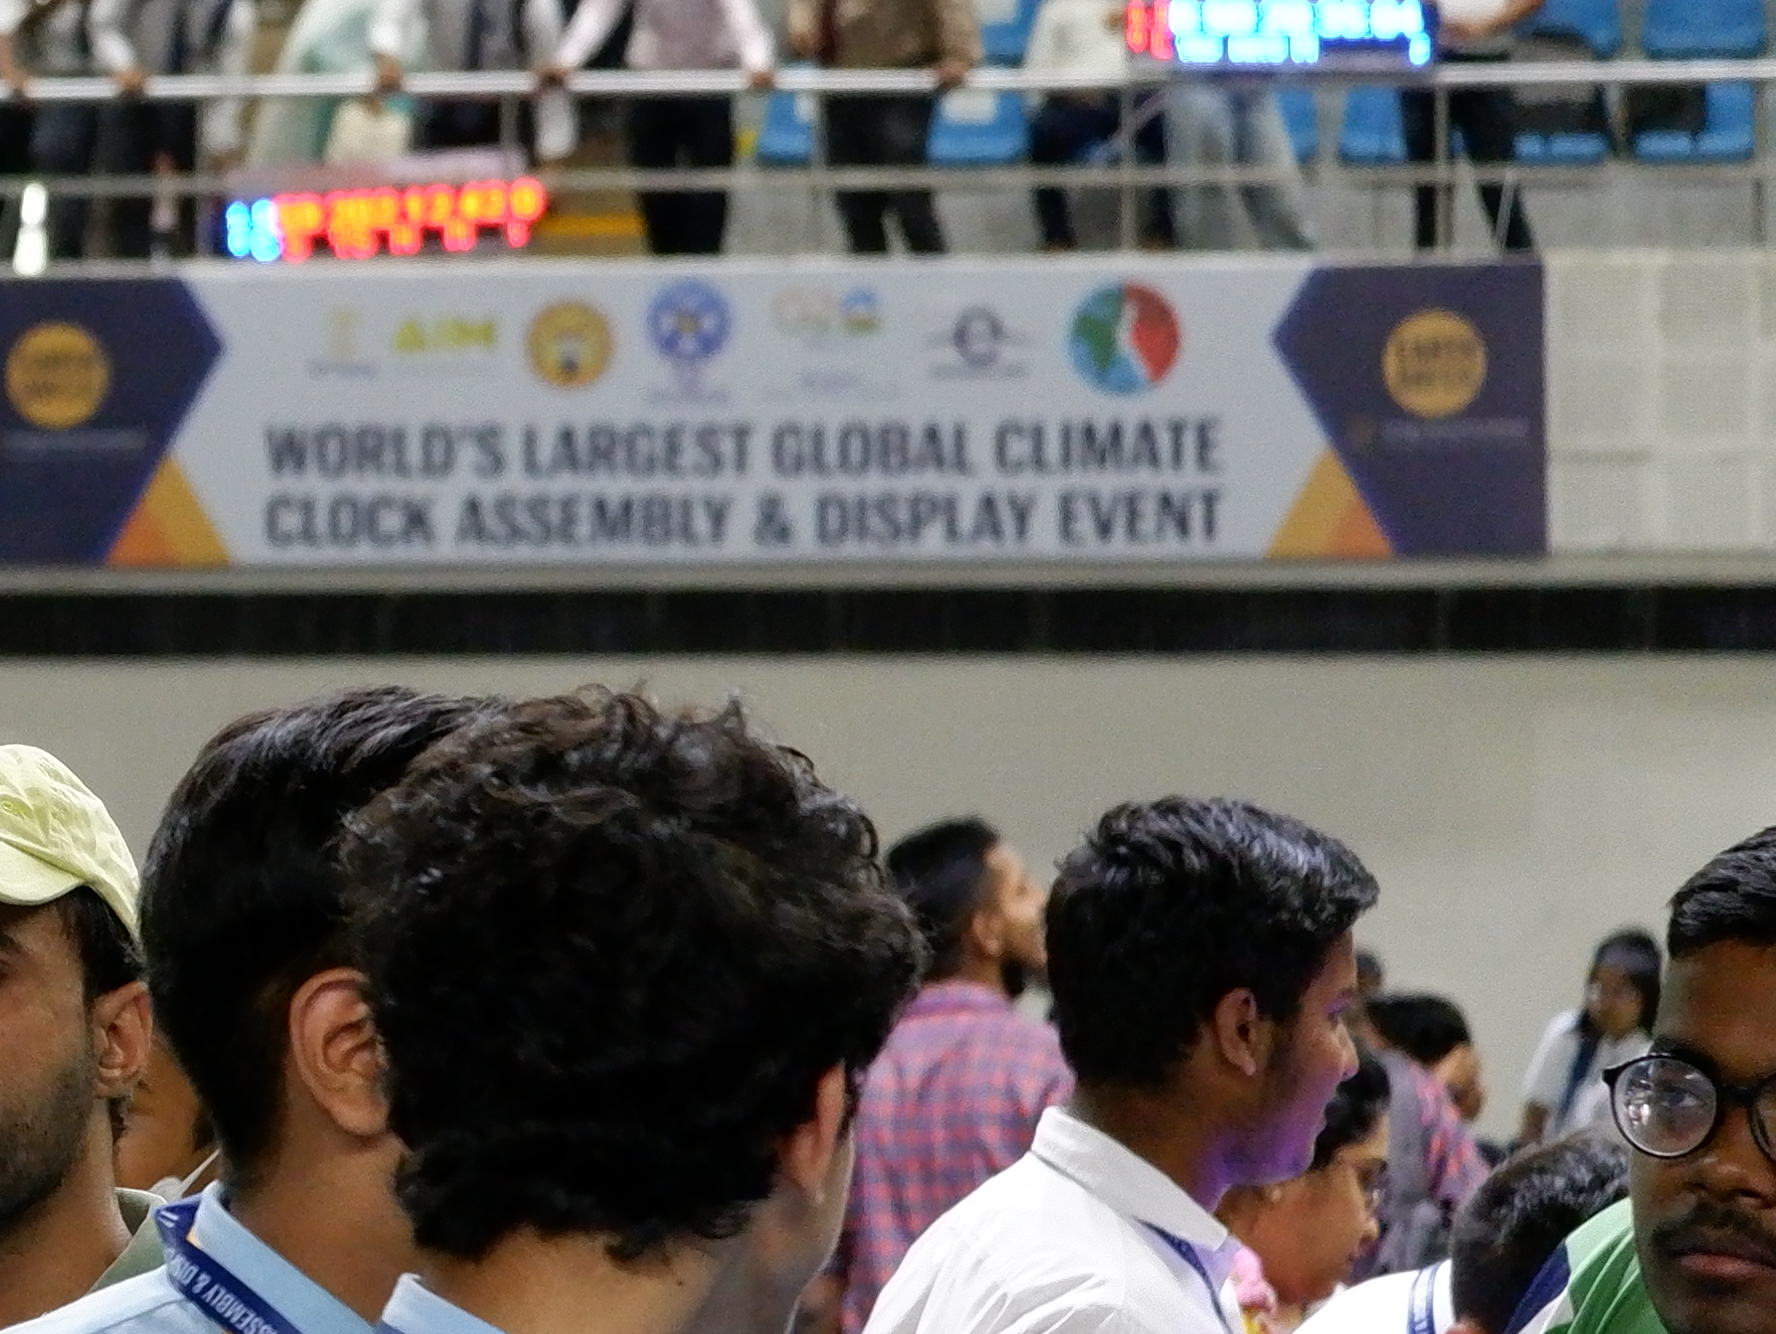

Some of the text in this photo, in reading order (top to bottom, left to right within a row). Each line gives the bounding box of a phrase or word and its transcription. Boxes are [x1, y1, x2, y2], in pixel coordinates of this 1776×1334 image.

[265, 417, 1221, 476] WORLD'S LARGEST GLOBAL CLIMATE
[265, 489, 1221, 548] CLOCK ASSEMBLY & DISPLAY EVENT
